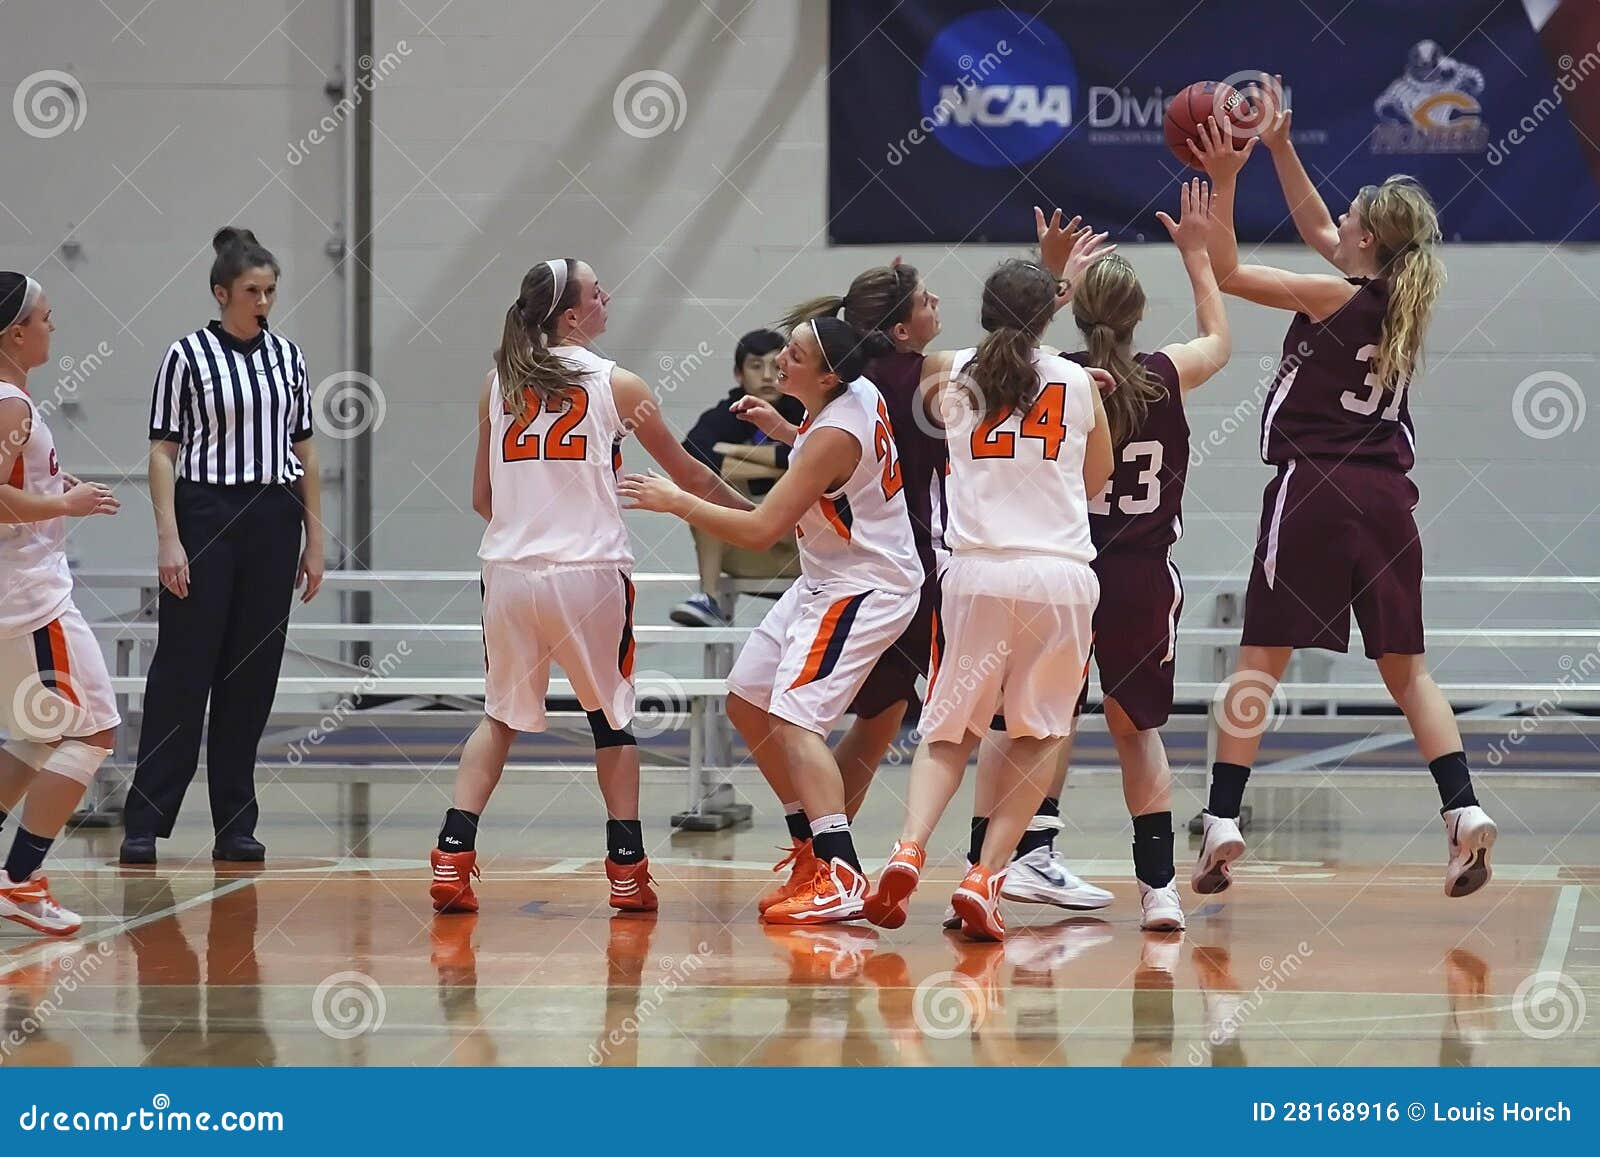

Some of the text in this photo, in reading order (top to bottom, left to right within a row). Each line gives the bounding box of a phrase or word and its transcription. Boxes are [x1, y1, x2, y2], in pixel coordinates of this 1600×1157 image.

[939, 84, 1073, 127] NCAA
[970, 382, 1067, 462] 24
[1340, 344, 1406, 421] 31
[503, 384, 589, 463] 22
[874, 396, 904, 502] 2
